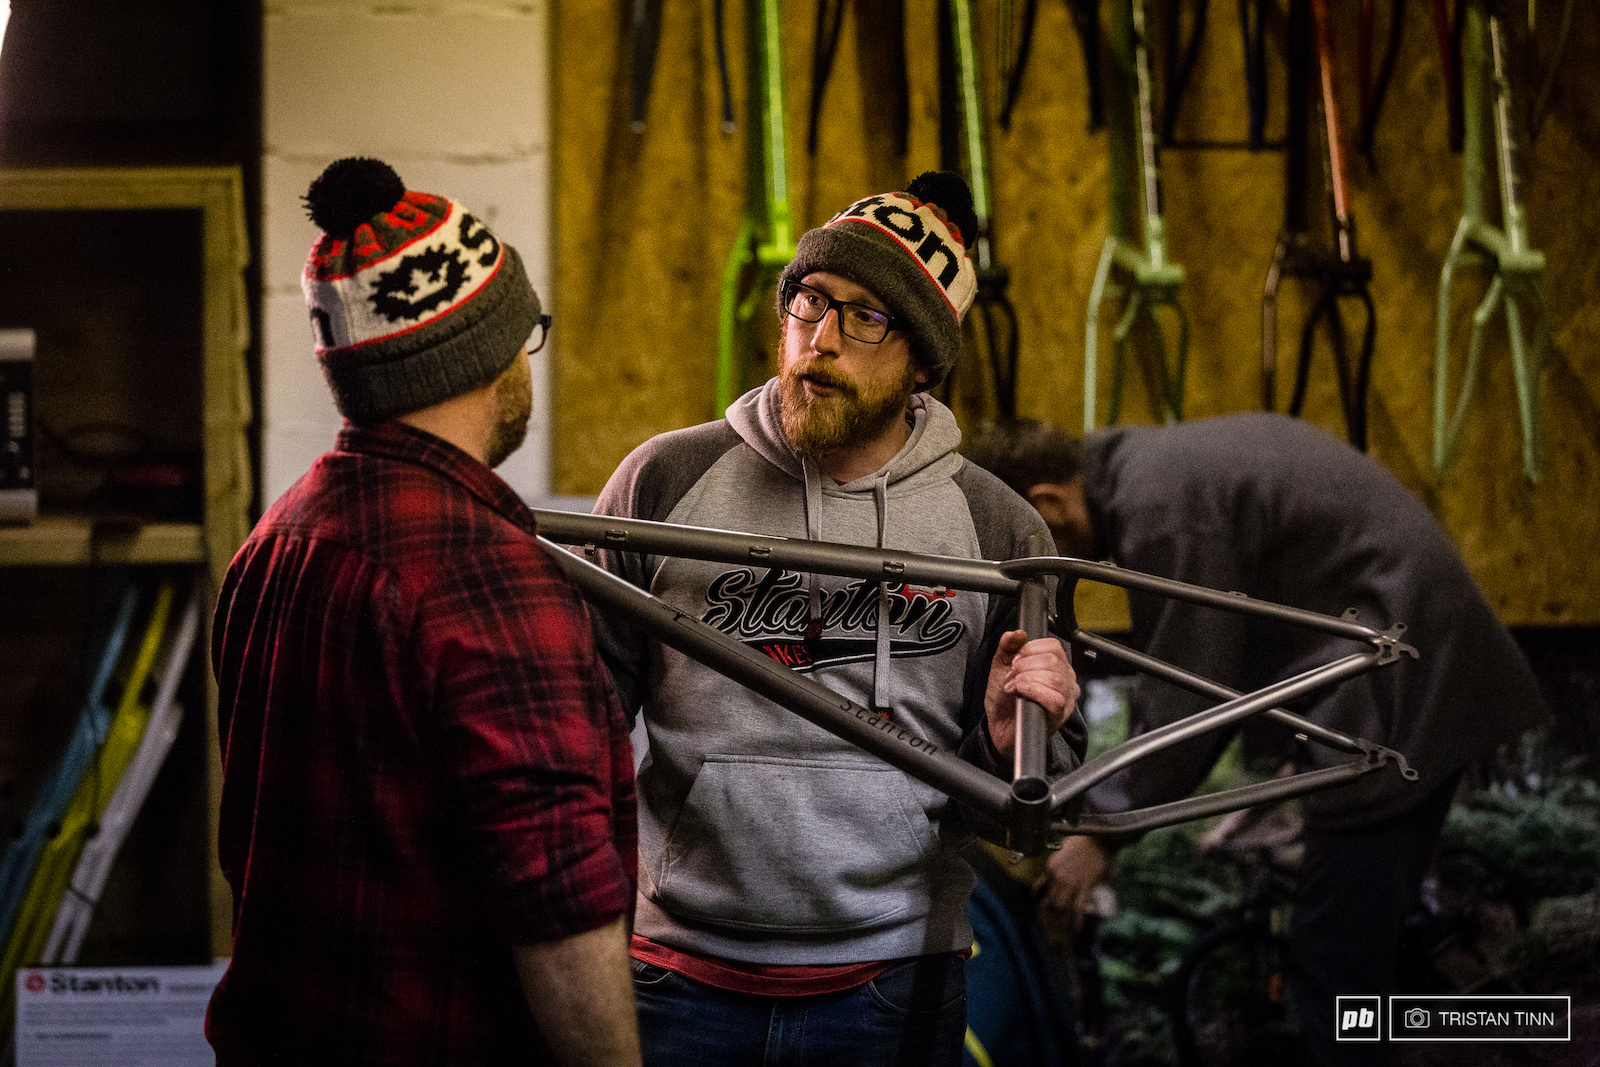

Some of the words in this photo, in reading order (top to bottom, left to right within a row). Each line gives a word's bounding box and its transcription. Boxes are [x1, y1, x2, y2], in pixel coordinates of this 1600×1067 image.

[700, 566, 964, 642] Stanton
[762, 643, 813, 667] IKES
[52, 973, 160, 994] Stanton
